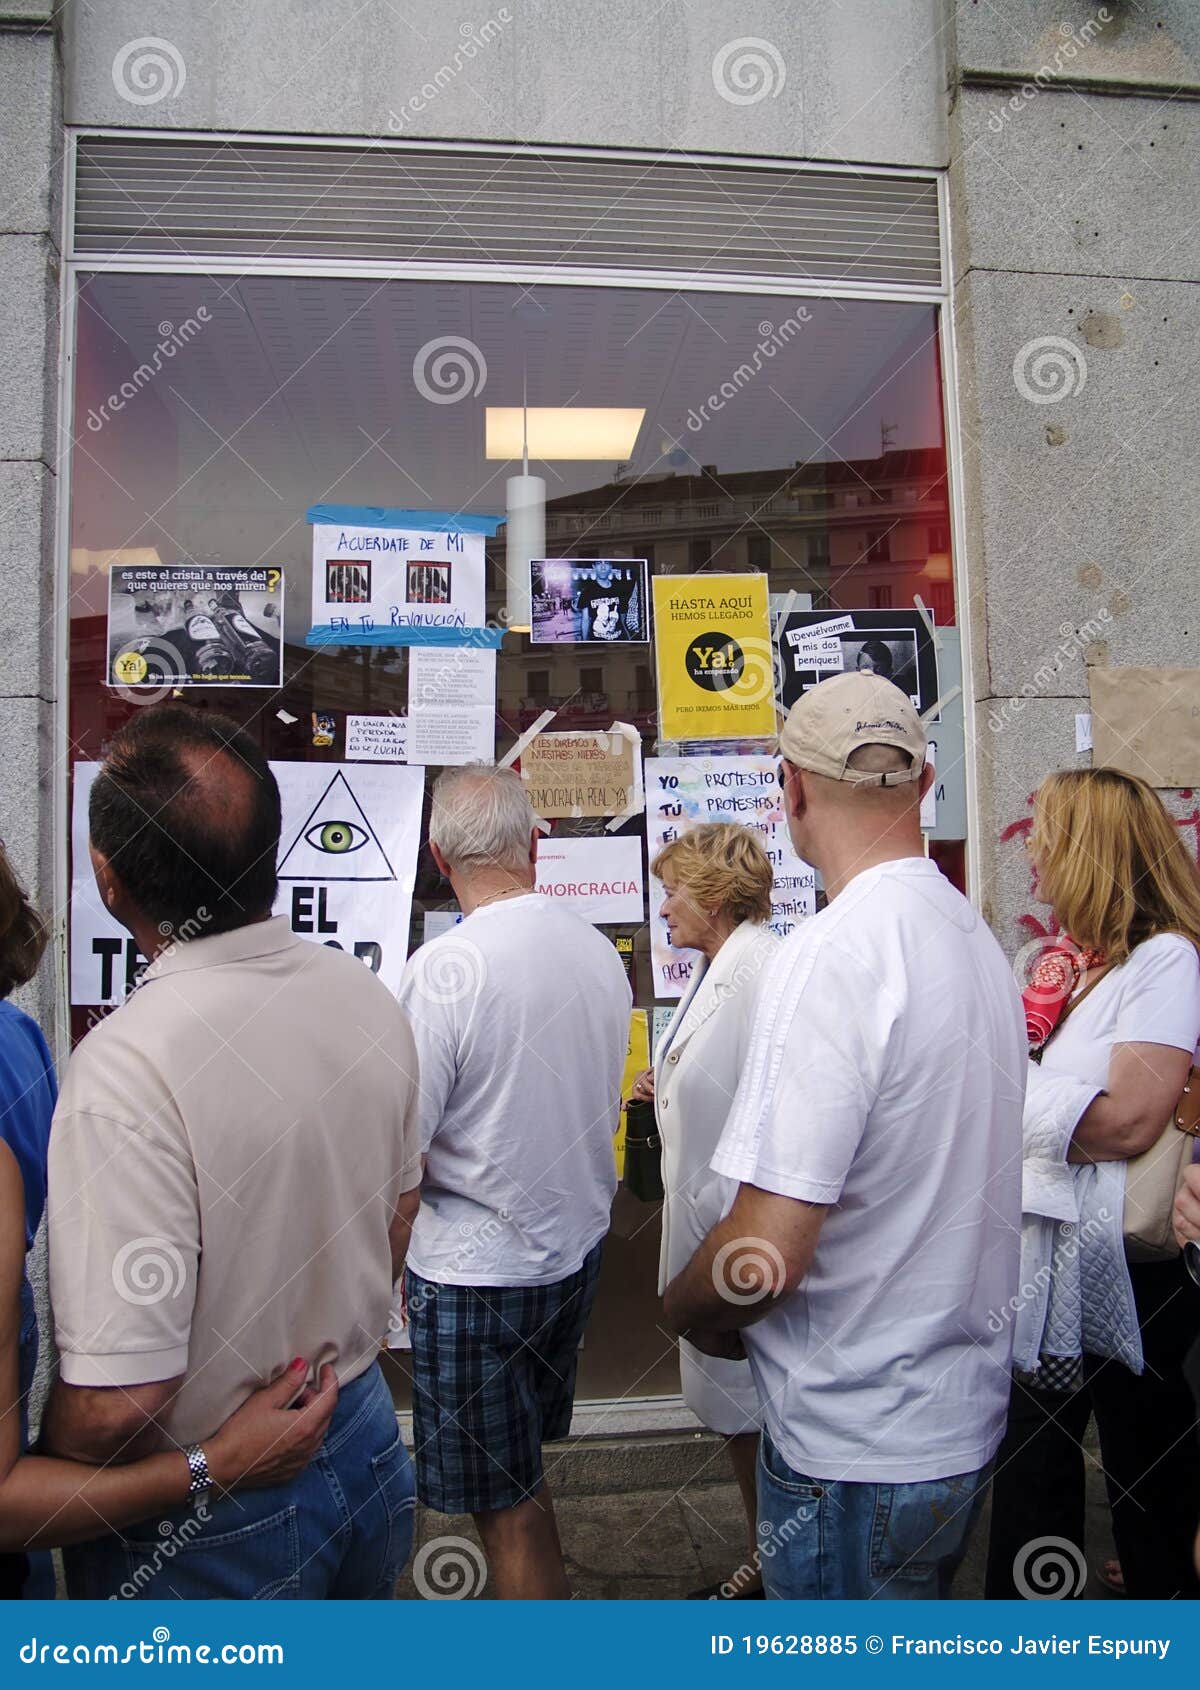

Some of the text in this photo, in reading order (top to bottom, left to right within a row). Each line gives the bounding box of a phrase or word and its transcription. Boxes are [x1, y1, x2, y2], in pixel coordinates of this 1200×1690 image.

[336, 532, 410, 553] ACUERDATE
[419, 537, 436, 550] DE
[121, 569, 267, 581] es este el cristal a través del
[127, 581, 148, 593] que
[149, 580, 189, 593] quieres
[190, 581, 211, 593] que
[213, 582, 233, 591] nos
[669, 594, 753, 611] HASTA AQUÍ
[671, 610, 754, 621] HEMOS LLEGADO
[329, 616, 350, 633] EN
[801, 640, 838, 652] mis dos
[692, 644, 735, 669] Ya!
[797, 655, 841, 667] peniques!
[373, 745, 405, 756] LUCHA
[658, 771, 775, 790] YO PROTESTO
[658, 799, 682, 817] TÚ
[538, 881, 639, 897] MORCRACIA
[291, 886, 338, 934] EL
